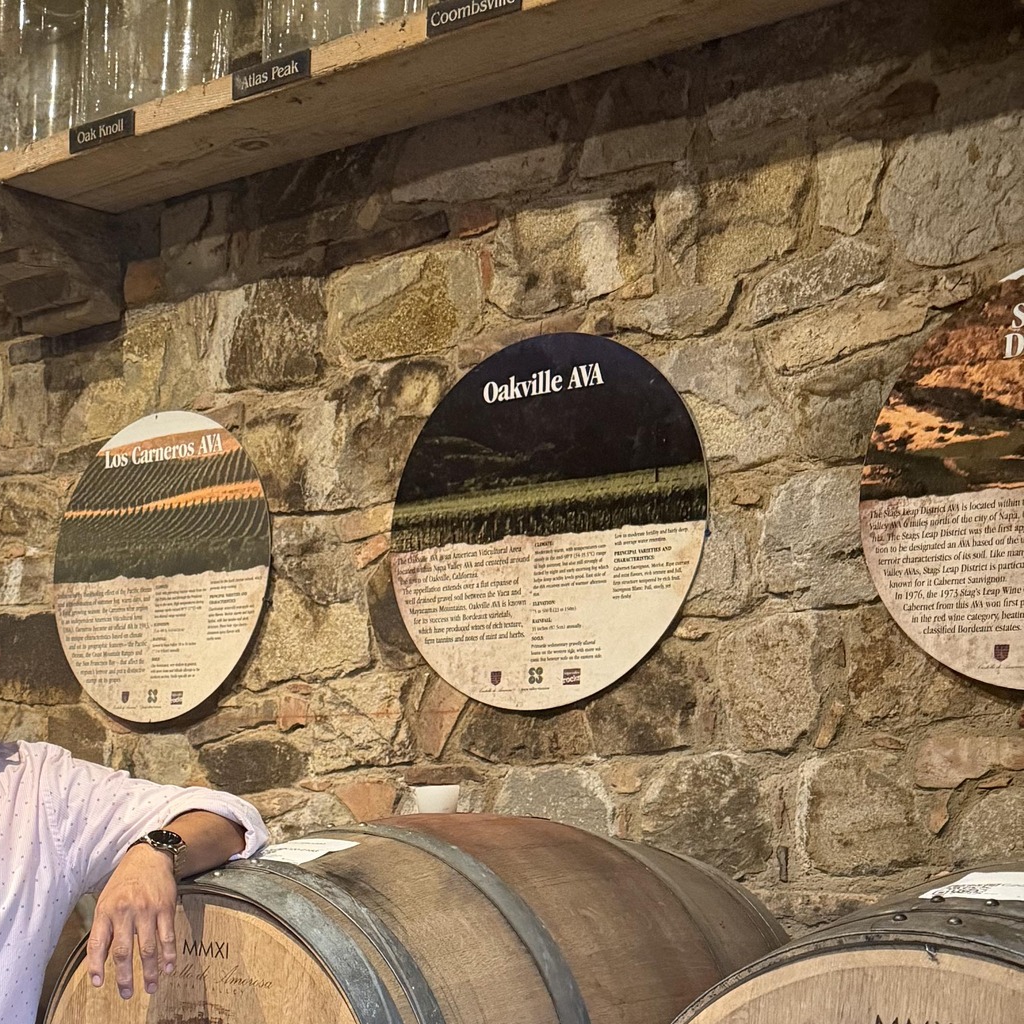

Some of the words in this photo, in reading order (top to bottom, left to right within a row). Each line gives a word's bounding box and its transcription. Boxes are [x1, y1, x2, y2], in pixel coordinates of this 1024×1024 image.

[240, 71, 268, 90] Atlas
[271, 60, 299, 80] Peak
[77, 128, 96, 144] Oak
[99, 118, 124, 137] Knoll
[483, 369, 563, 404] Oakville
[567, 362, 604, 390] AVA
[104, 450, 129, 469] Los
[131, 442, 195, 465] Carneros
[197, 433, 223, 455] AVA
[914, 578, 925, 587] for
[933, 575, 966, 587] Cabernet
[926, 589, 938, 598] the
[982, 586, 1000, 598] Leap
[1002, 585, 1021, 595] Wine
[957, 624, 993, 634] Bordeaux
[995, 623, 1021, 633] estates.
[183, 939, 229, 959] MMXI
[215, 965, 273, 989] Amorosa
